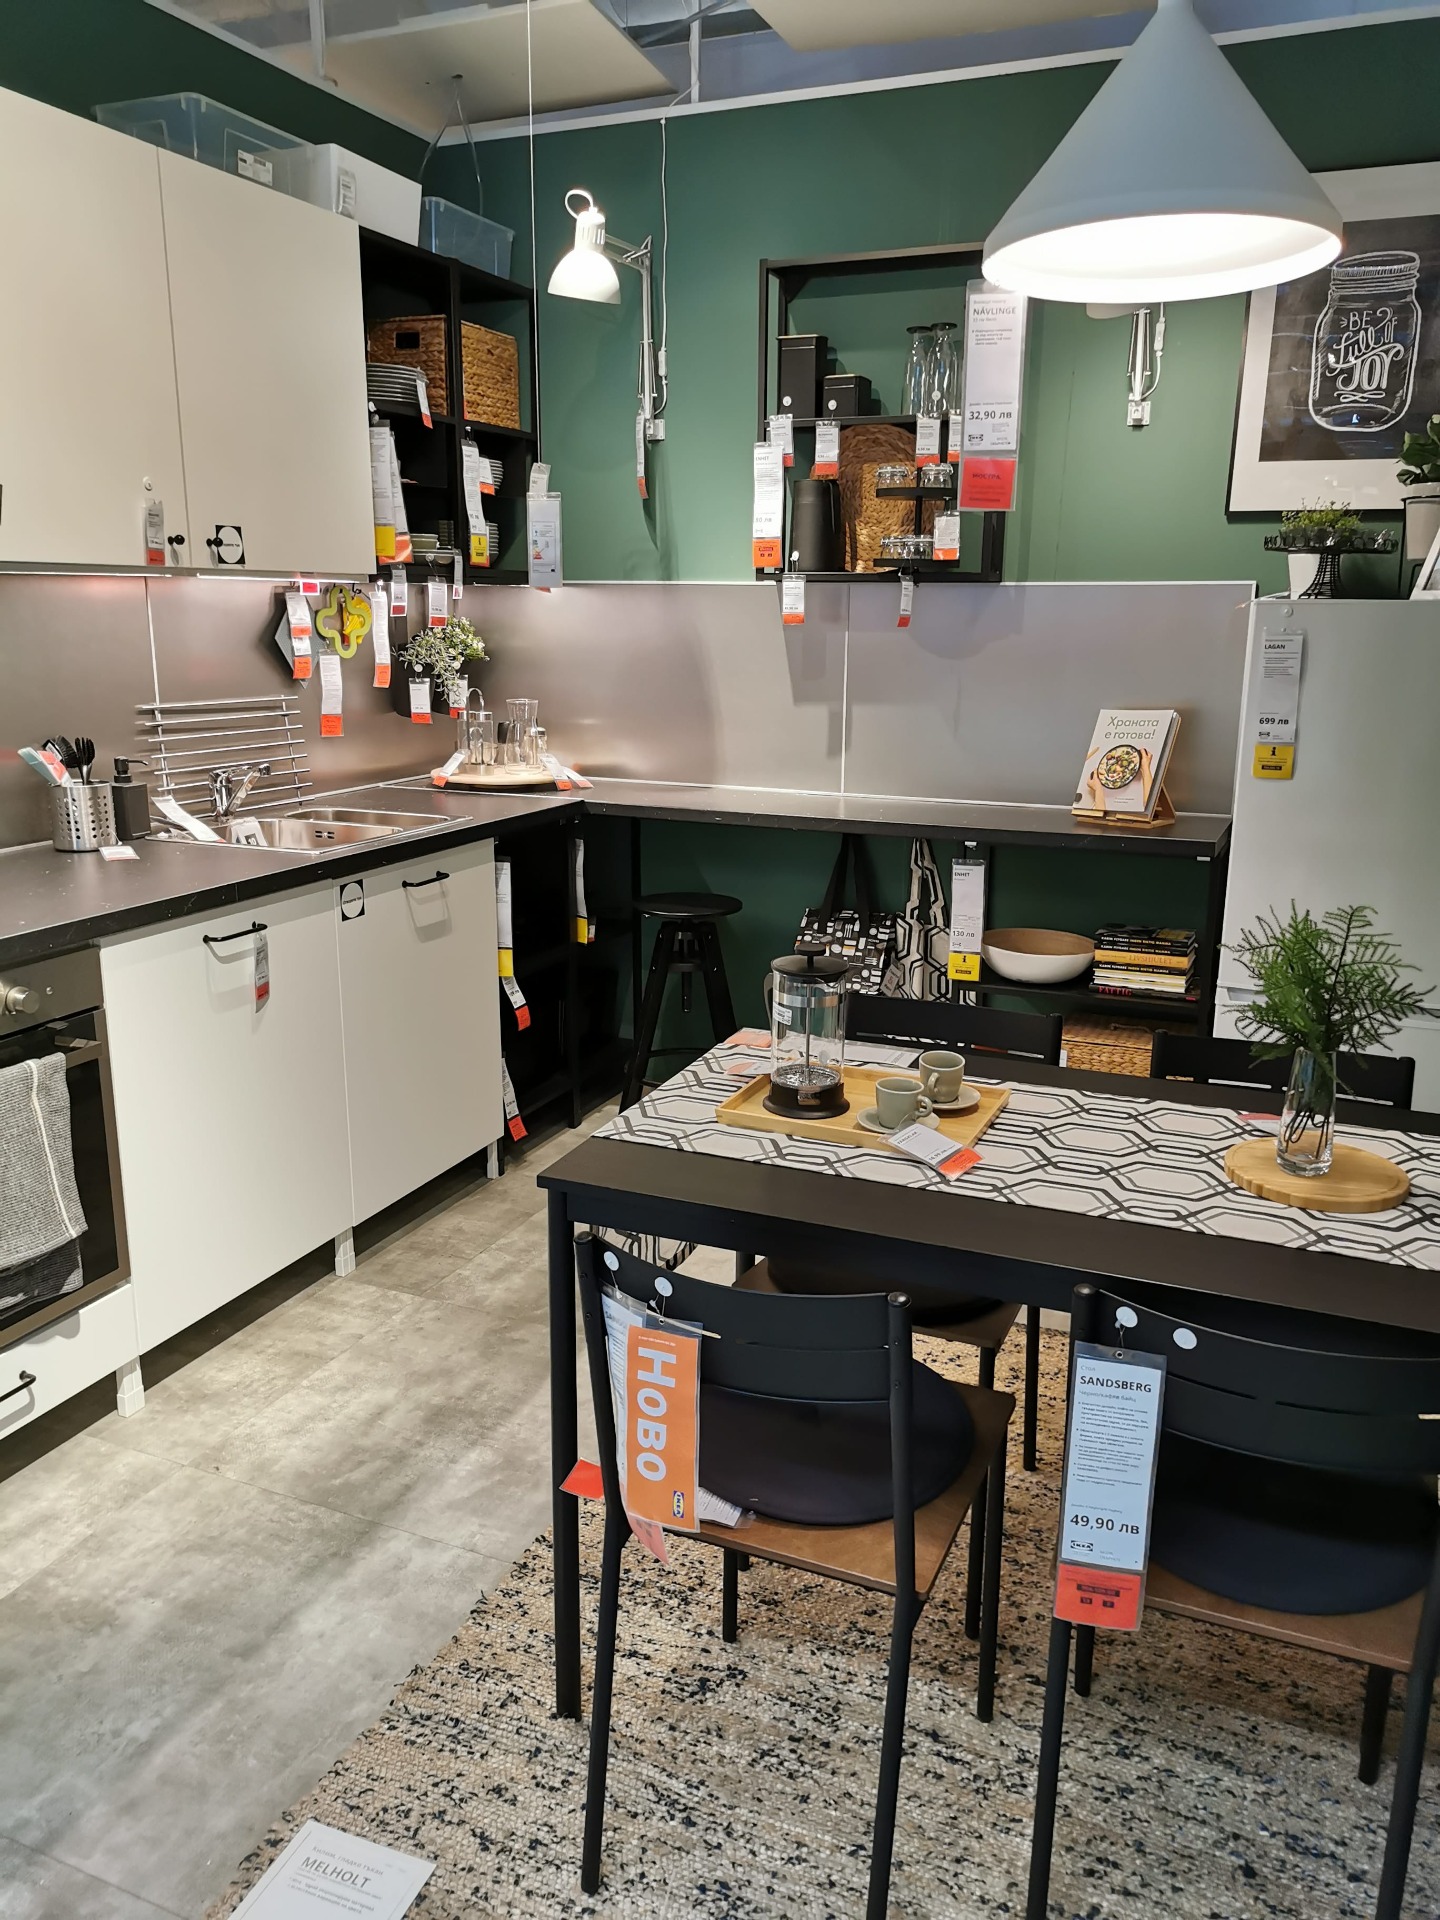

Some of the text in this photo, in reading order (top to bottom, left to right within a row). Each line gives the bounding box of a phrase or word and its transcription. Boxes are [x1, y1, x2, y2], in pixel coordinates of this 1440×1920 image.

[1349, 310, 1373, 331] BE
[1383, 316, 1398, 344] OF
[1328, 343, 1404, 391] JOY
[968, 410, 1012, 421] 32,90 лв
[1107, 716, 1159, 730] Храната
[1258, 717, 1276, 725] 699
[1113, 729, 1156, 740] готова!
[1079, 1375, 1152, 1393] SANDSBERG
[1070, 1513, 1140, 1535] 49,90 лв
[300, 1856, 371, 1888] MELHOLT
